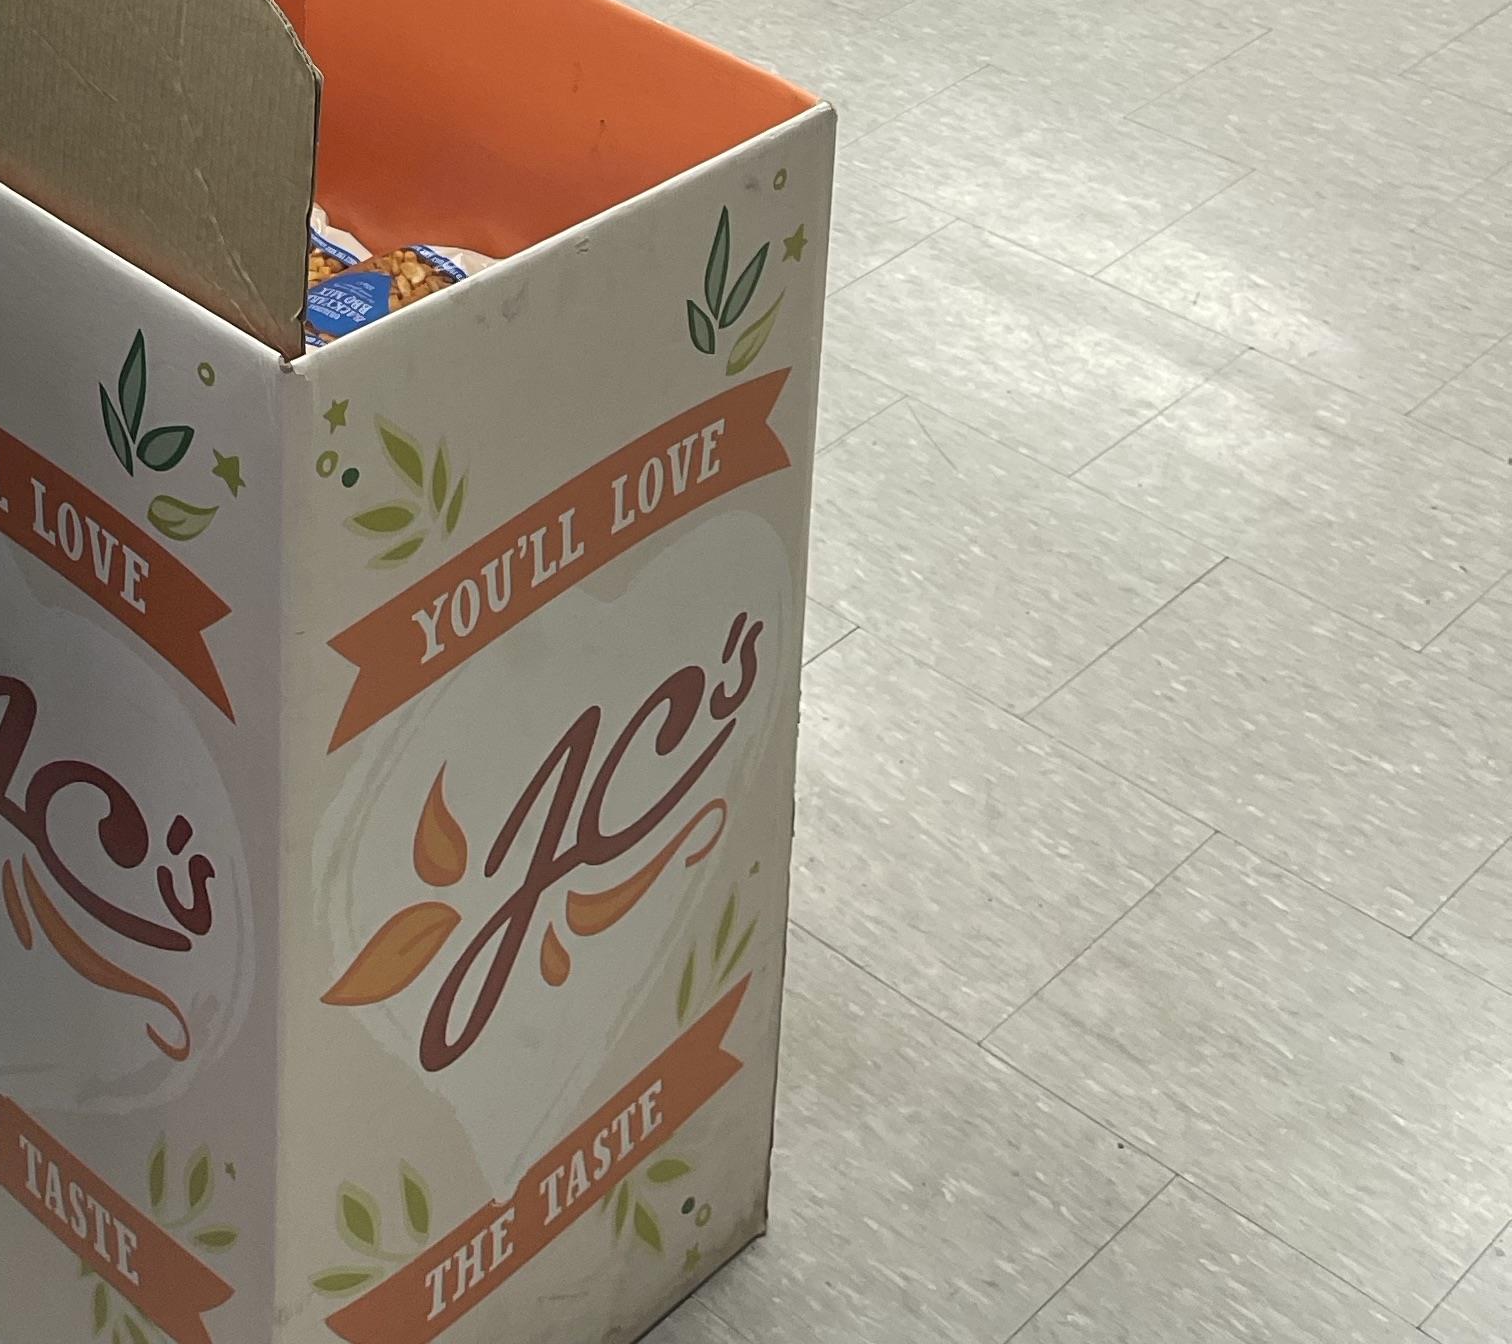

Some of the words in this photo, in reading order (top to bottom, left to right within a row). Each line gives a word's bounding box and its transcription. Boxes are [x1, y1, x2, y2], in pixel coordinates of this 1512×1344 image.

[31, 477, 152, 615] LOVE
[410, 506, 585, 667] YOU'LL
[610, 418, 726, 526] LOVE
[19, 1132, 142, 1287] TASTE
[424, 1206, 516, 1322] THE
[538, 1078, 664, 1213] TASTE
